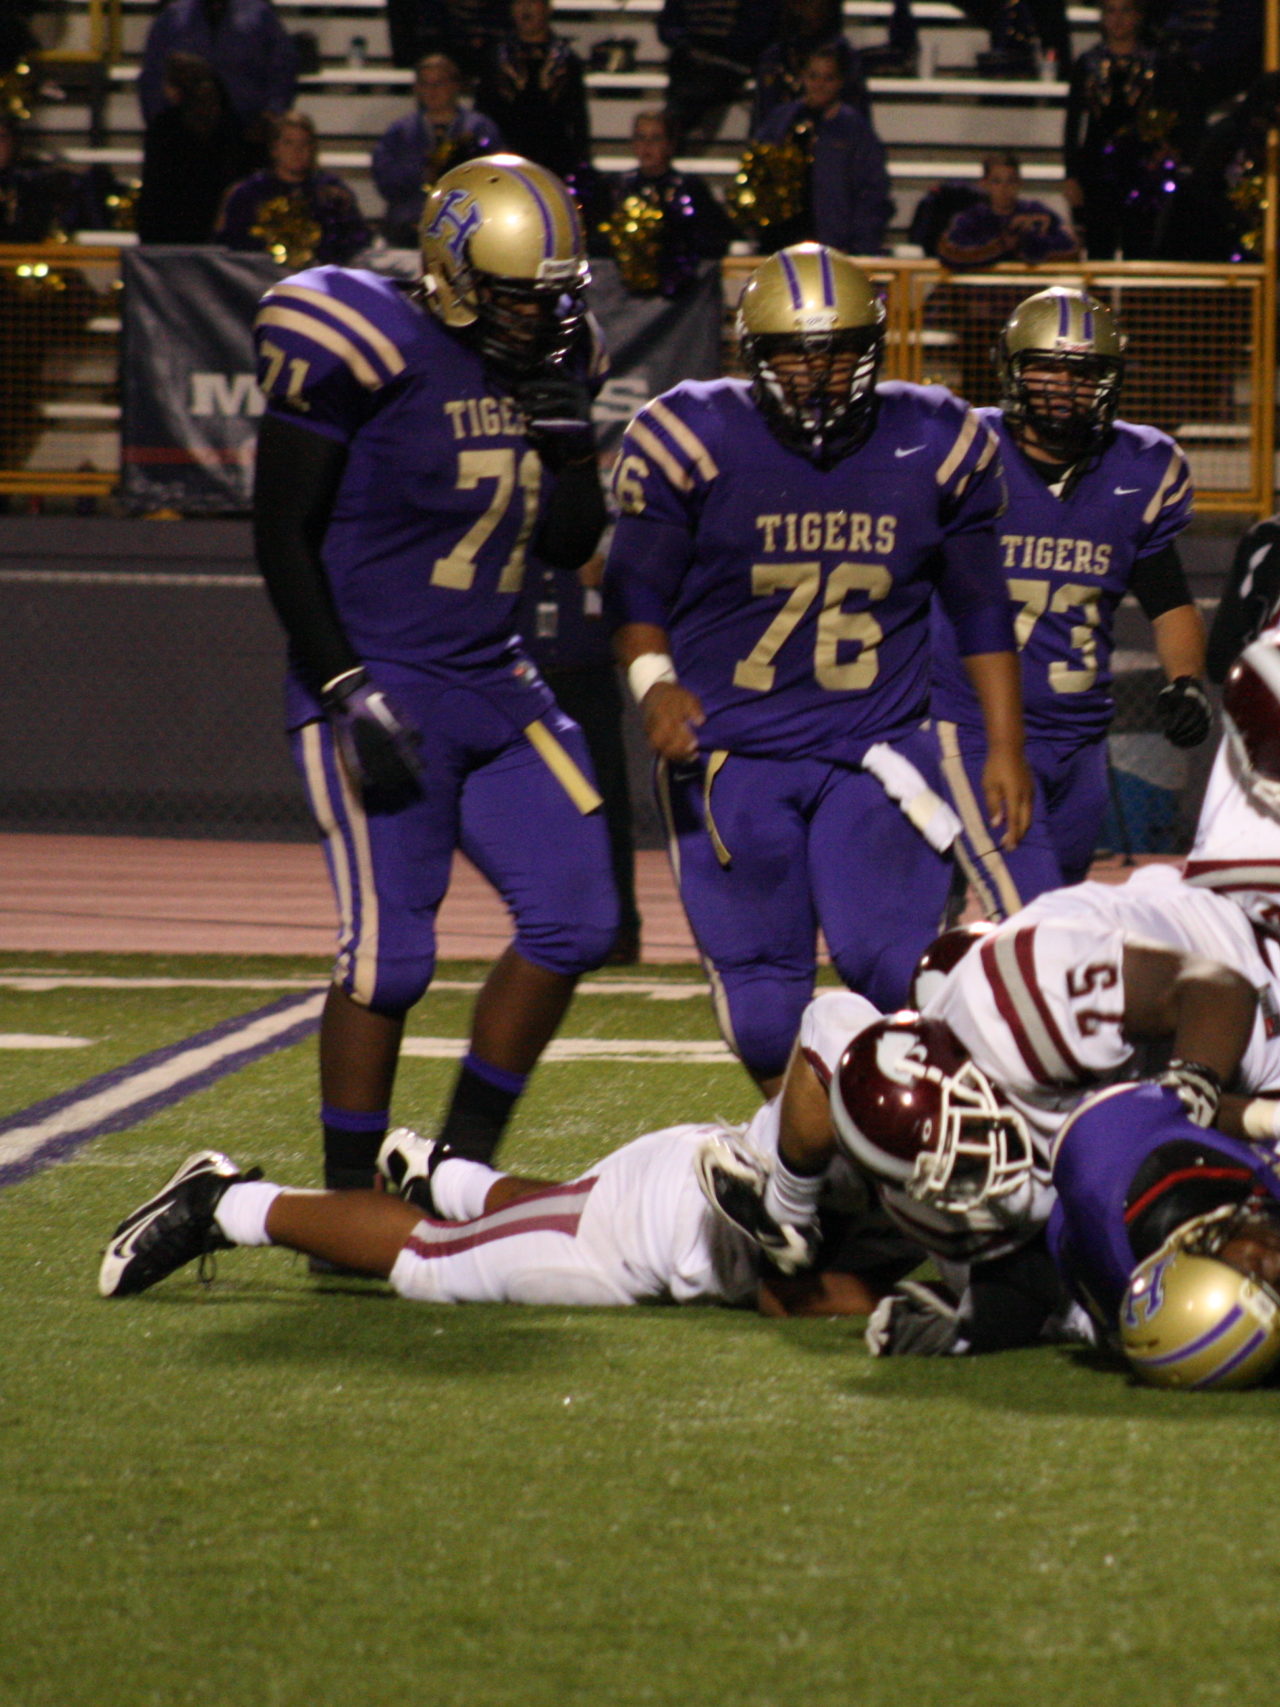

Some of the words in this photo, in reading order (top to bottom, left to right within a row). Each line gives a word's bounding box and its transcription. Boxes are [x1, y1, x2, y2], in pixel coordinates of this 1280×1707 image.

[260, 339, 310, 412] 71
[443, 396, 541, 440] TIGE
[611, 452, 650, 515] 6
[429, 448, 543, 593] 71
[755, 511, 898, 554] TIGERS
[1000, 535, 1113, 576] TIGERS
[732, 561, 894, 692] 76
[1006, 578, 1104, 694] 73
